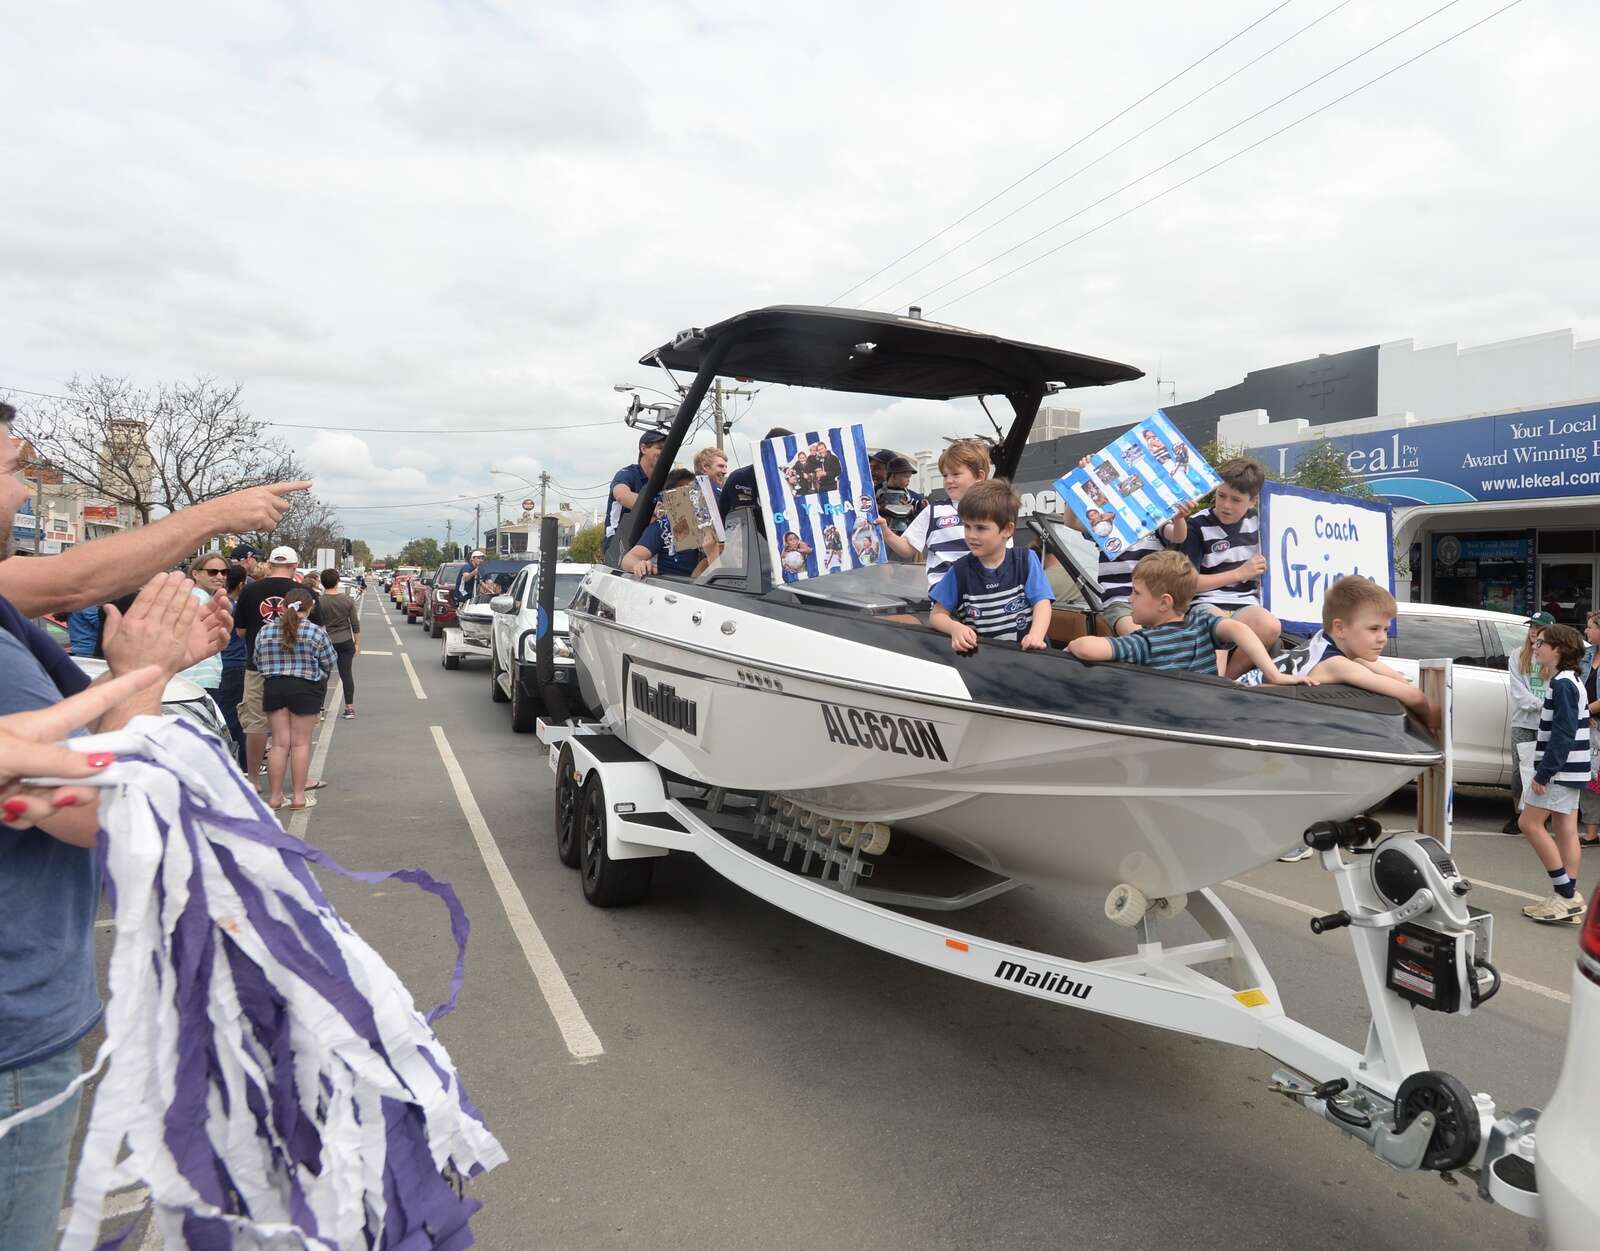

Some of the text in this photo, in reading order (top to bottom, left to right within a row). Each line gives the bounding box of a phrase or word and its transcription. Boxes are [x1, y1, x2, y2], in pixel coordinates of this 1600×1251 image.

[1510, 415, 1597, 439] Your Local
[1462, 449, 1508, 468] Award
[1512, 443, 1588, 463] Winning
[1315, 514, 1359, 542] Coach
[821, 703, 949, 762] ALC620N
